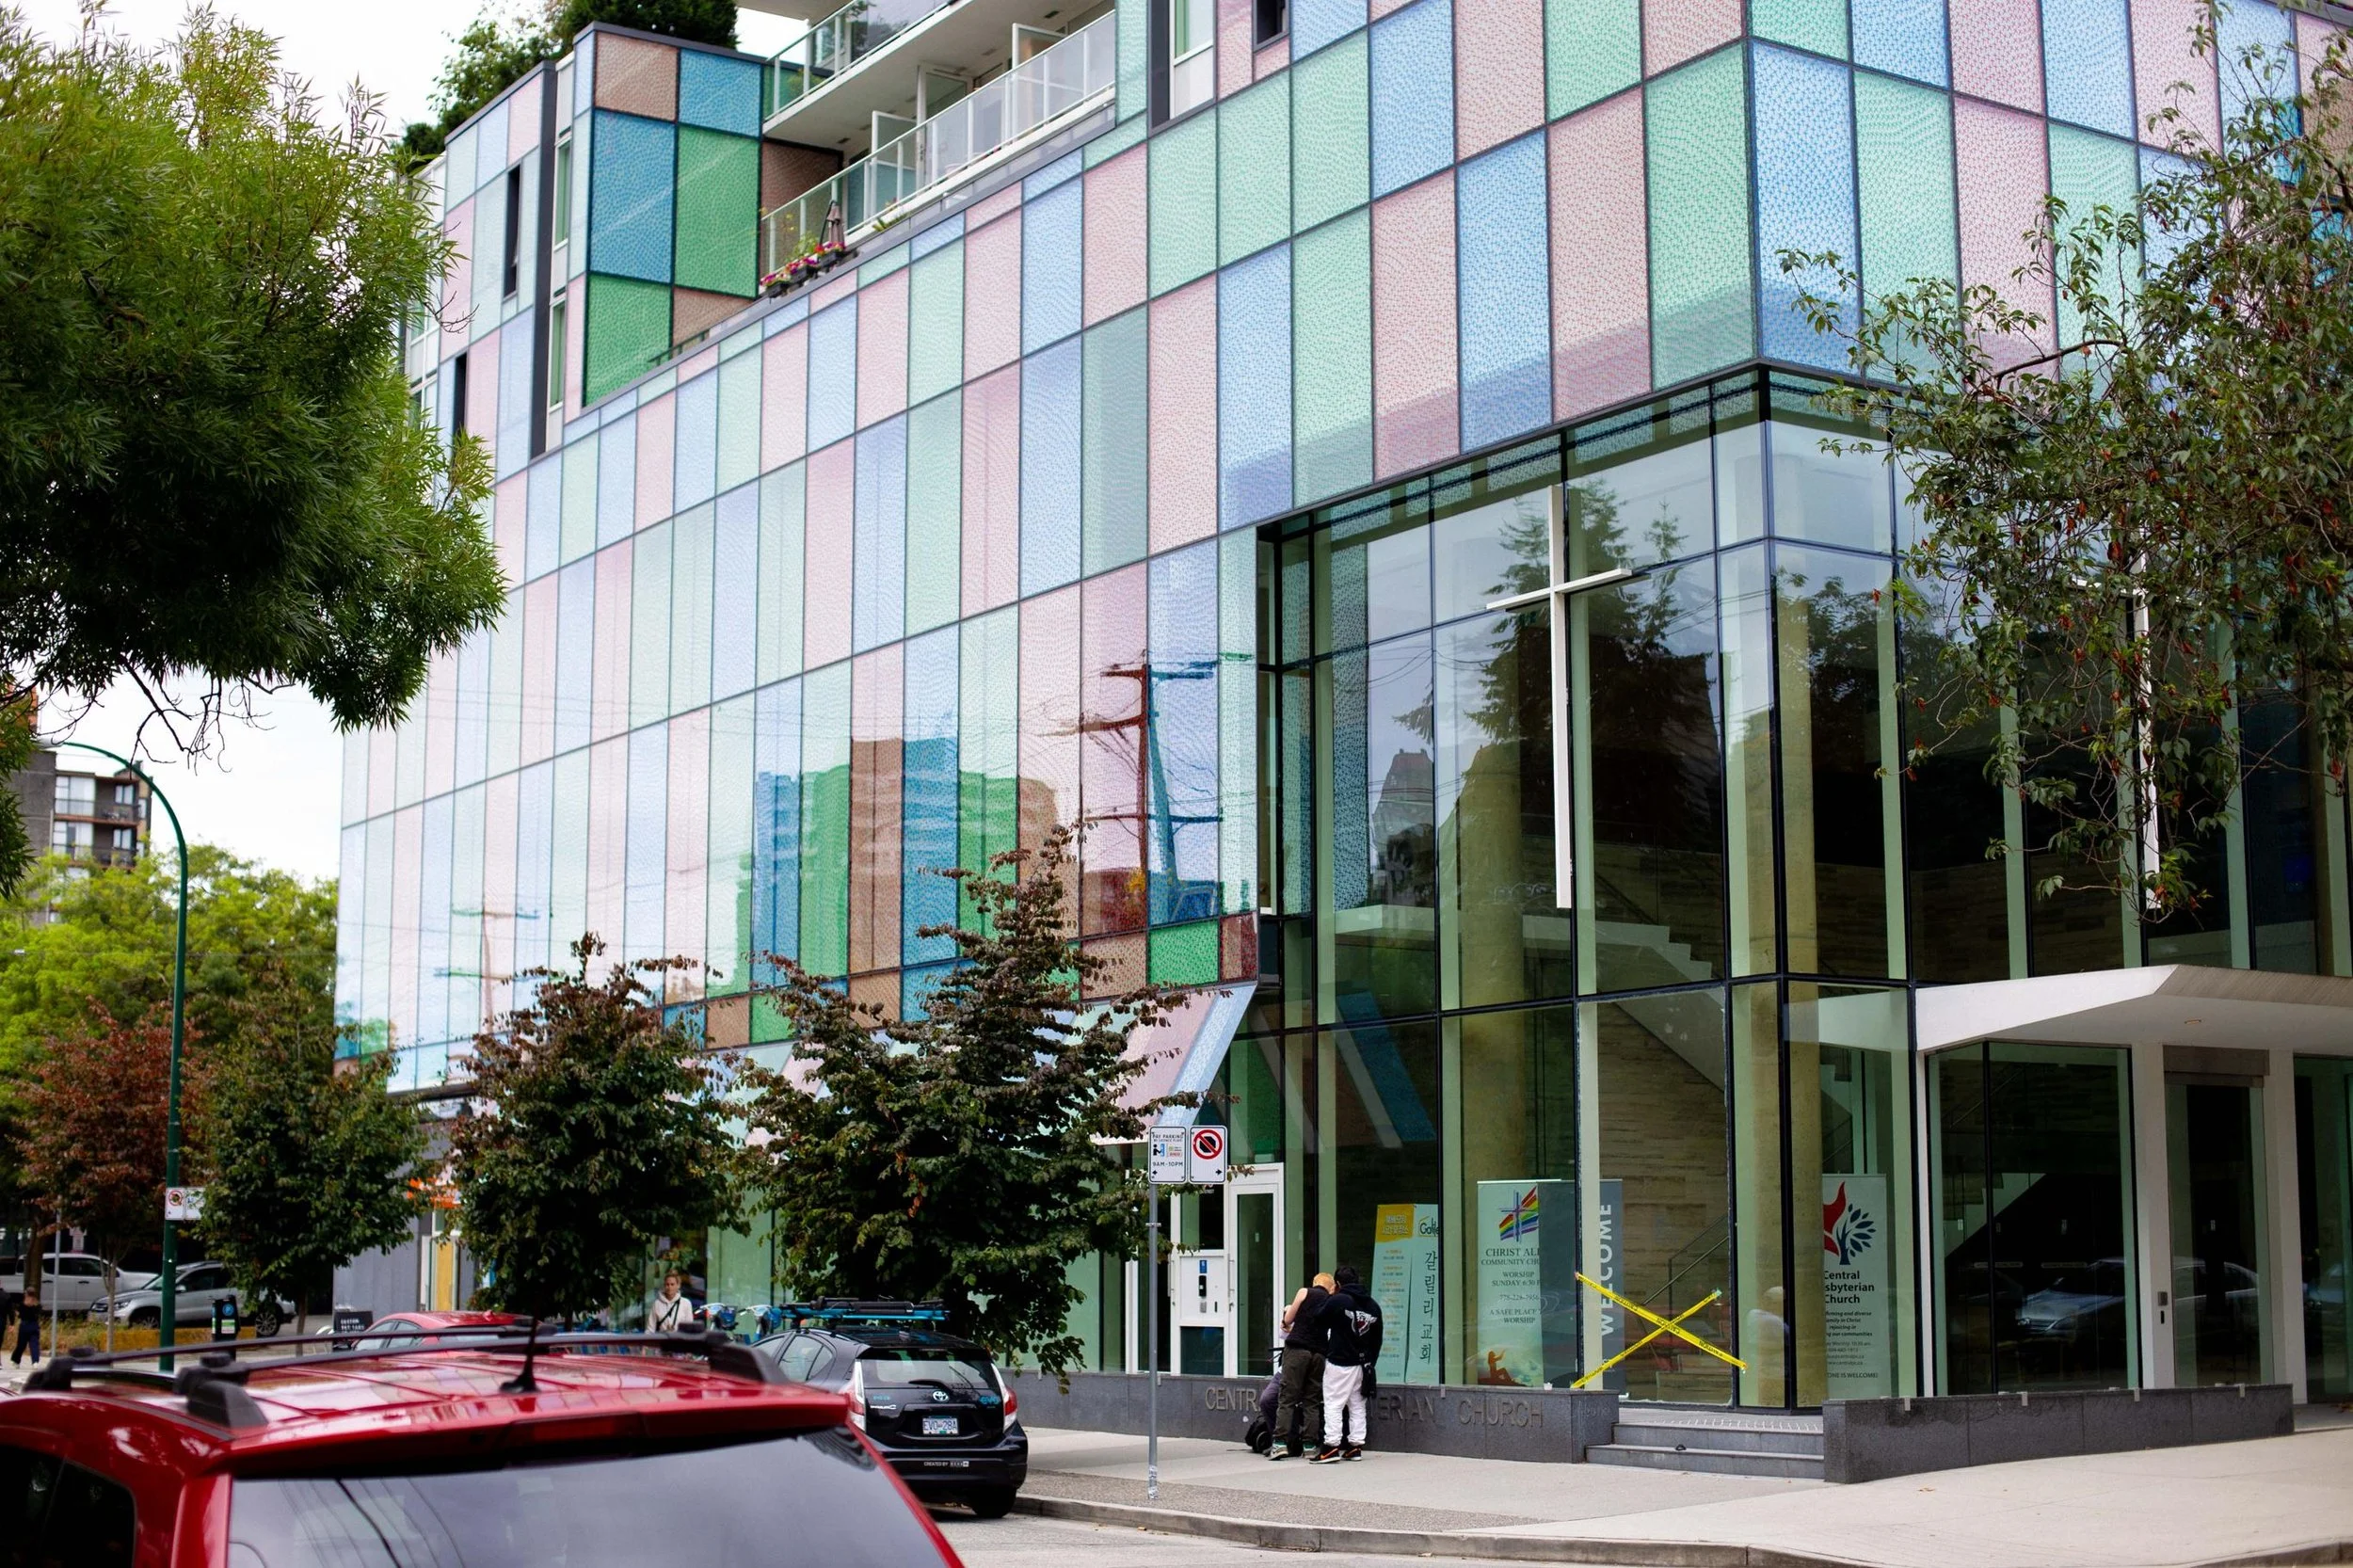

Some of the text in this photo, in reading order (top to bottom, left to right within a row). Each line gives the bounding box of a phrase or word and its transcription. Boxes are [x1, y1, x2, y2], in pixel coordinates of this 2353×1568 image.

[1486, 1248, 1520, 1256] CHRIST
[1419, 1250, 1438, 1365] 갈릴리교회
[1205, 1387, 1261, 1412] CENTR
[1459, 1398, 1544, 1428] CHURCH
